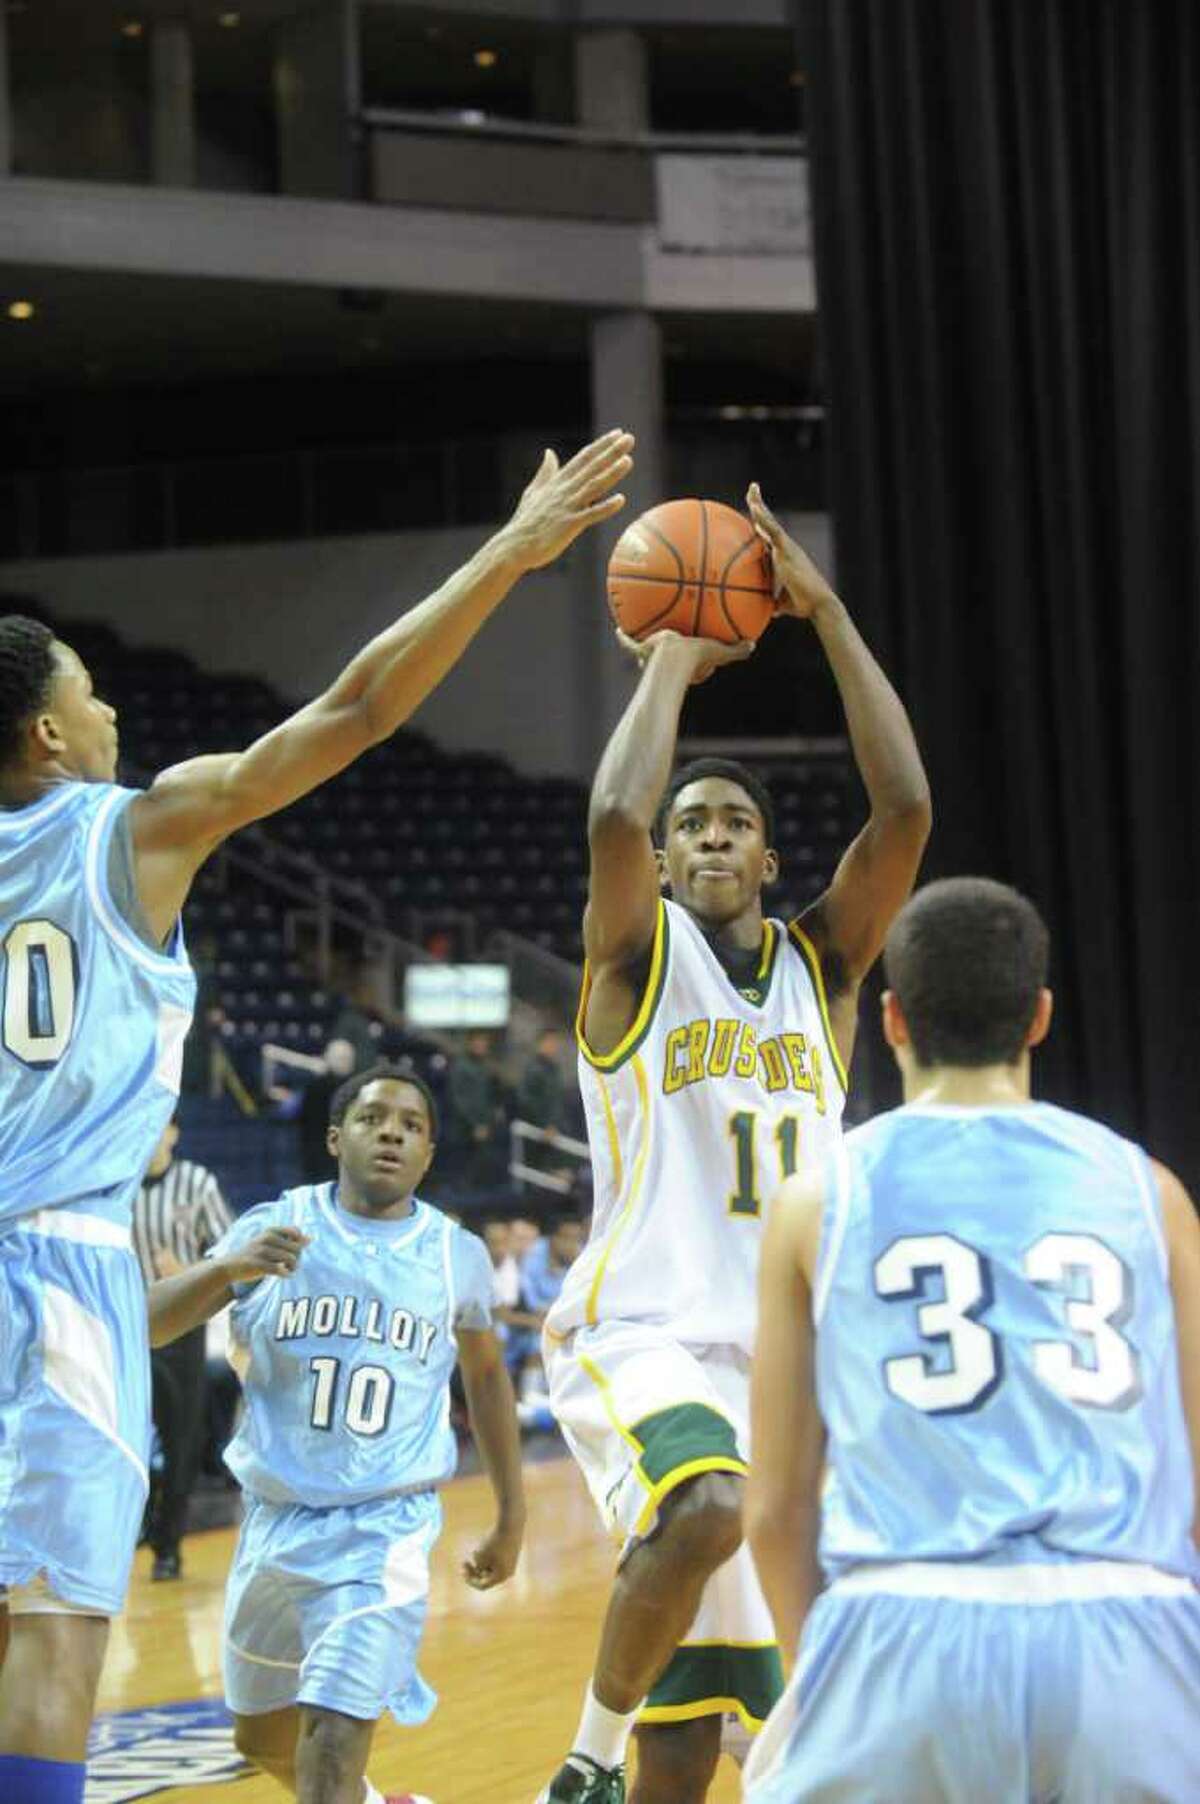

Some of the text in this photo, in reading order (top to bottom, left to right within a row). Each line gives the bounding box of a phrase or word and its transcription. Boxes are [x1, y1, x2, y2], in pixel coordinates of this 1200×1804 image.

[662, 1018, 826, 1116] CRUSDE
[727, 1110, 801, 1221] 11
[275, 1295, 437, 1365] MOLLOY
[873, 1231, 1144, 1416] 33
[310, 1356, 395, 1437] 10
